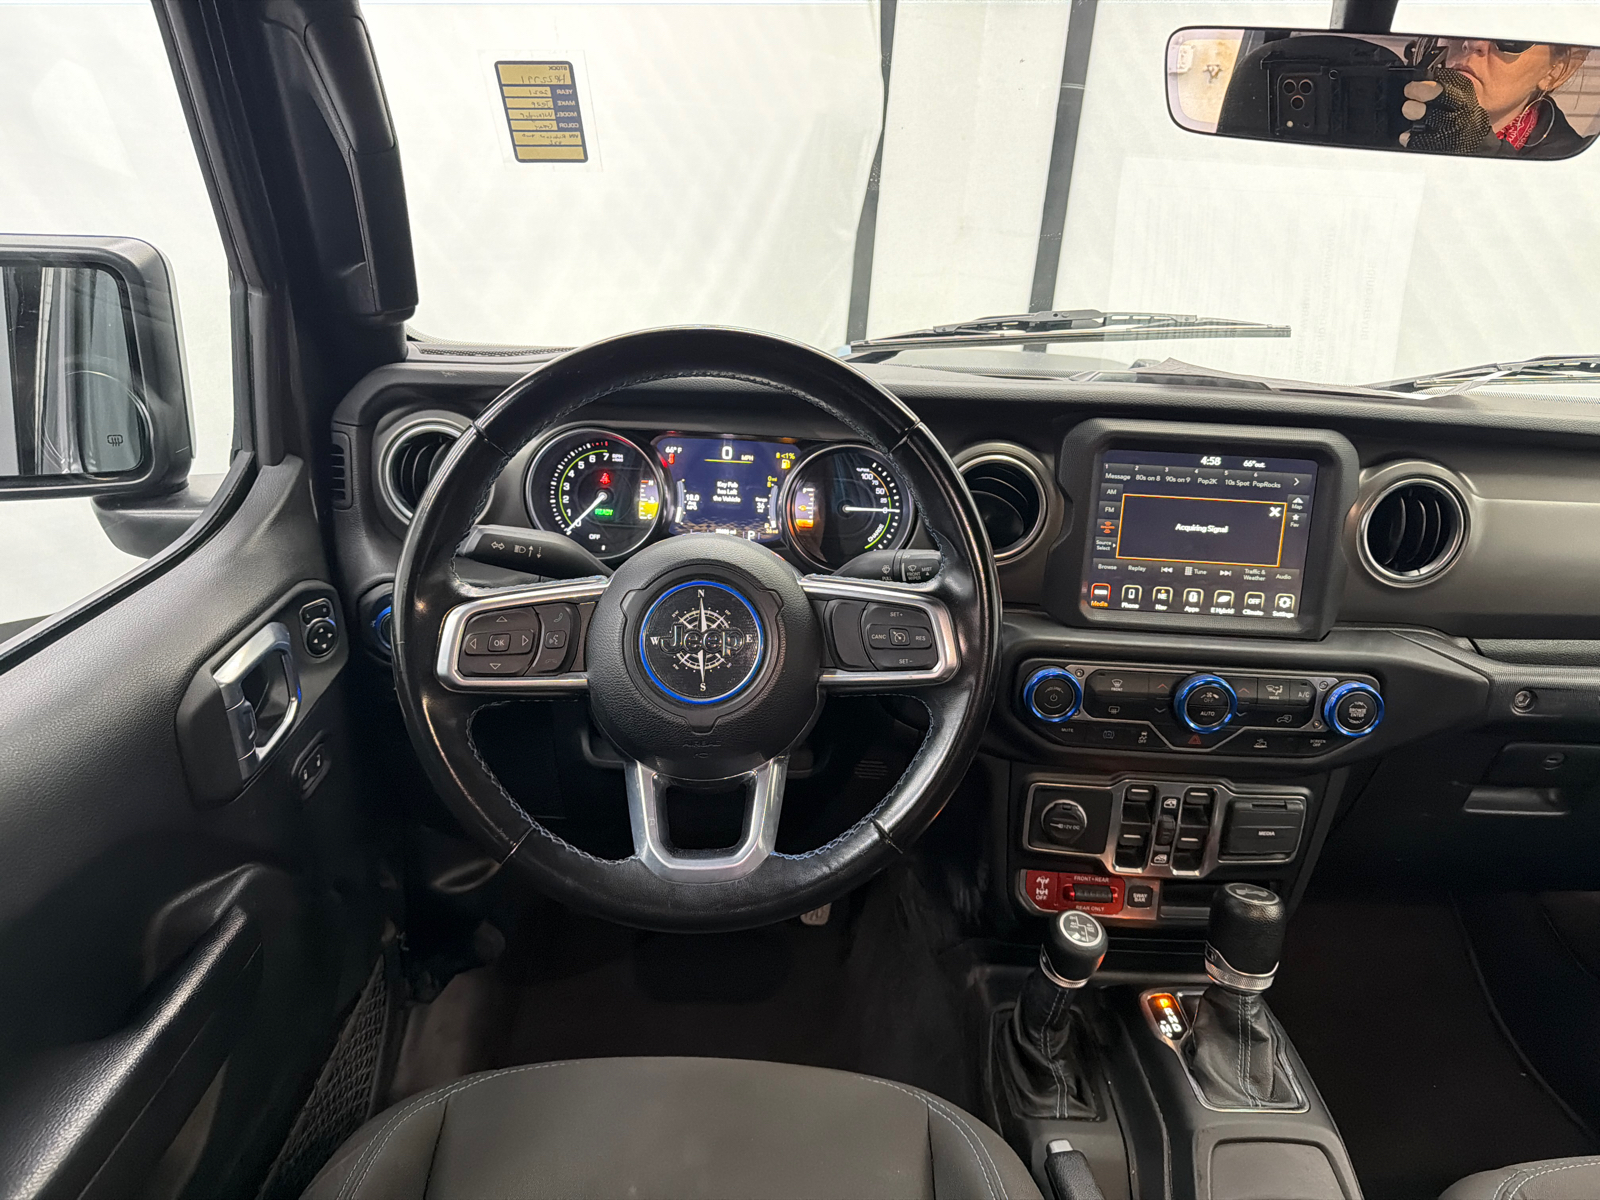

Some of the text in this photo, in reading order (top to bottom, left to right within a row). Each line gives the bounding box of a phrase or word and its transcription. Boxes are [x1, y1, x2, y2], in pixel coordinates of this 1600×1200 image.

[603, 452, 609, 461] 7
[722, 446, 733, 459] 0
[588, 454, 596, 463] 6
[578, 461, 585, 469] 5
[568, 469, 575, 478] 4
[1105, 473, 1131, 481] Message
[716, 481, 739, 489] Key Fob
[1197, 477, 1218, 485] Pop2K
[1252, 480, 1281, 488] PopRocks
[563, 482, 570, 491] 3
[875, 487, 885, 495] 50
[562, 495, 570, 504] 2
[722, 495, 741, 503] Vehicle
[566, 508, 572, 517] 1
[1174, 522, 1229, 534] Acquiring Signal
[748, 530, 756, 540] P
[1128, 564, 1147, 573] Replay
[697, 589, 705, 598] N
[1090, 600, 1109, 608] Media
[1184, 605, 1200, 613] Apps
[1215, 607, 1235, 615] Hybrid
[1242, 608, 1265, 616] Climate
[1272, 610, 1295, 618] Settings
[494, 639, 505, 647] OK
[650, 636, 660, 645] W
[660, 624, 744, 657] Jeep
[746, 634, 753, 643] E
[700, 682, 707, 692] S
